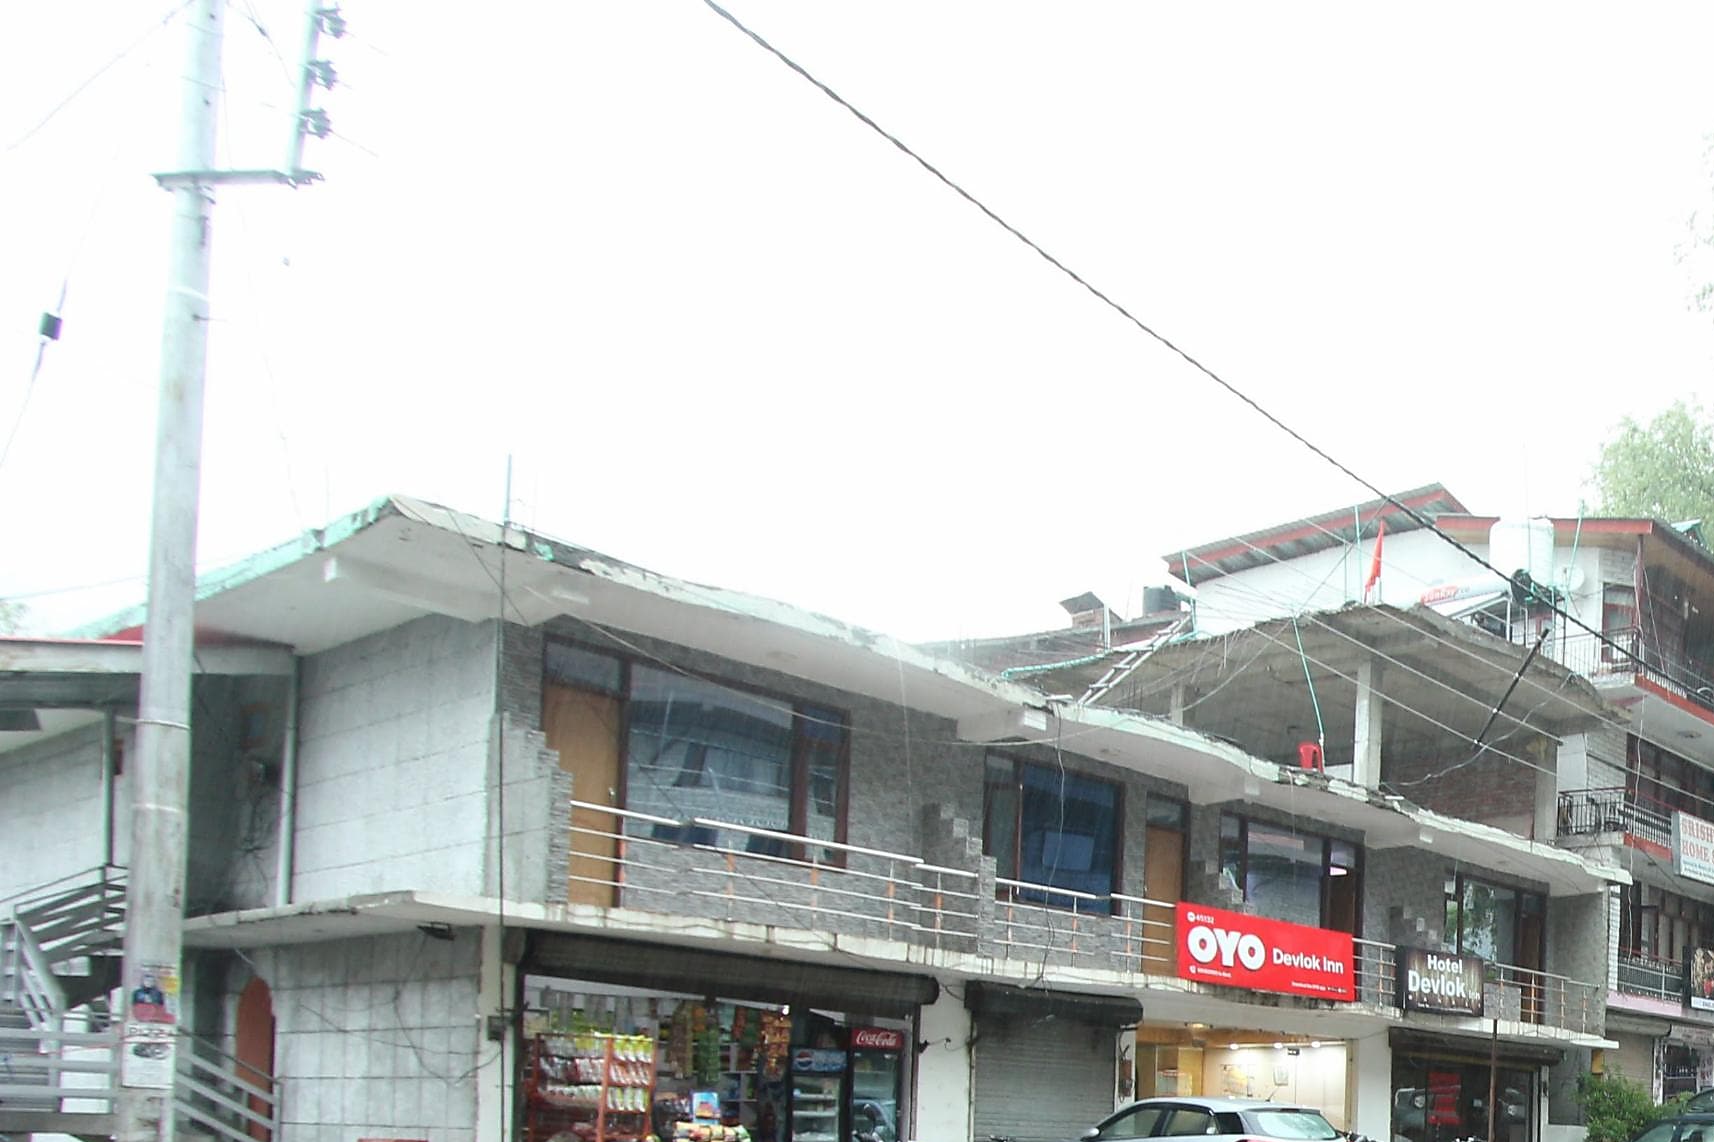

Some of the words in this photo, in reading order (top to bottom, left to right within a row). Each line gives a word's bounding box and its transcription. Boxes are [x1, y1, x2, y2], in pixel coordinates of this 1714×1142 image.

[1682, 840, 1710, 862] HOME
[1187, 925, 1266, 971] OYO
[1272, 947, 1321, 972] Devlok
[1323, 956, 1344, 974] Inn
[1427, 953, 1463, 975] Hotel
[1407, 969, 1466, 998] Devlok
